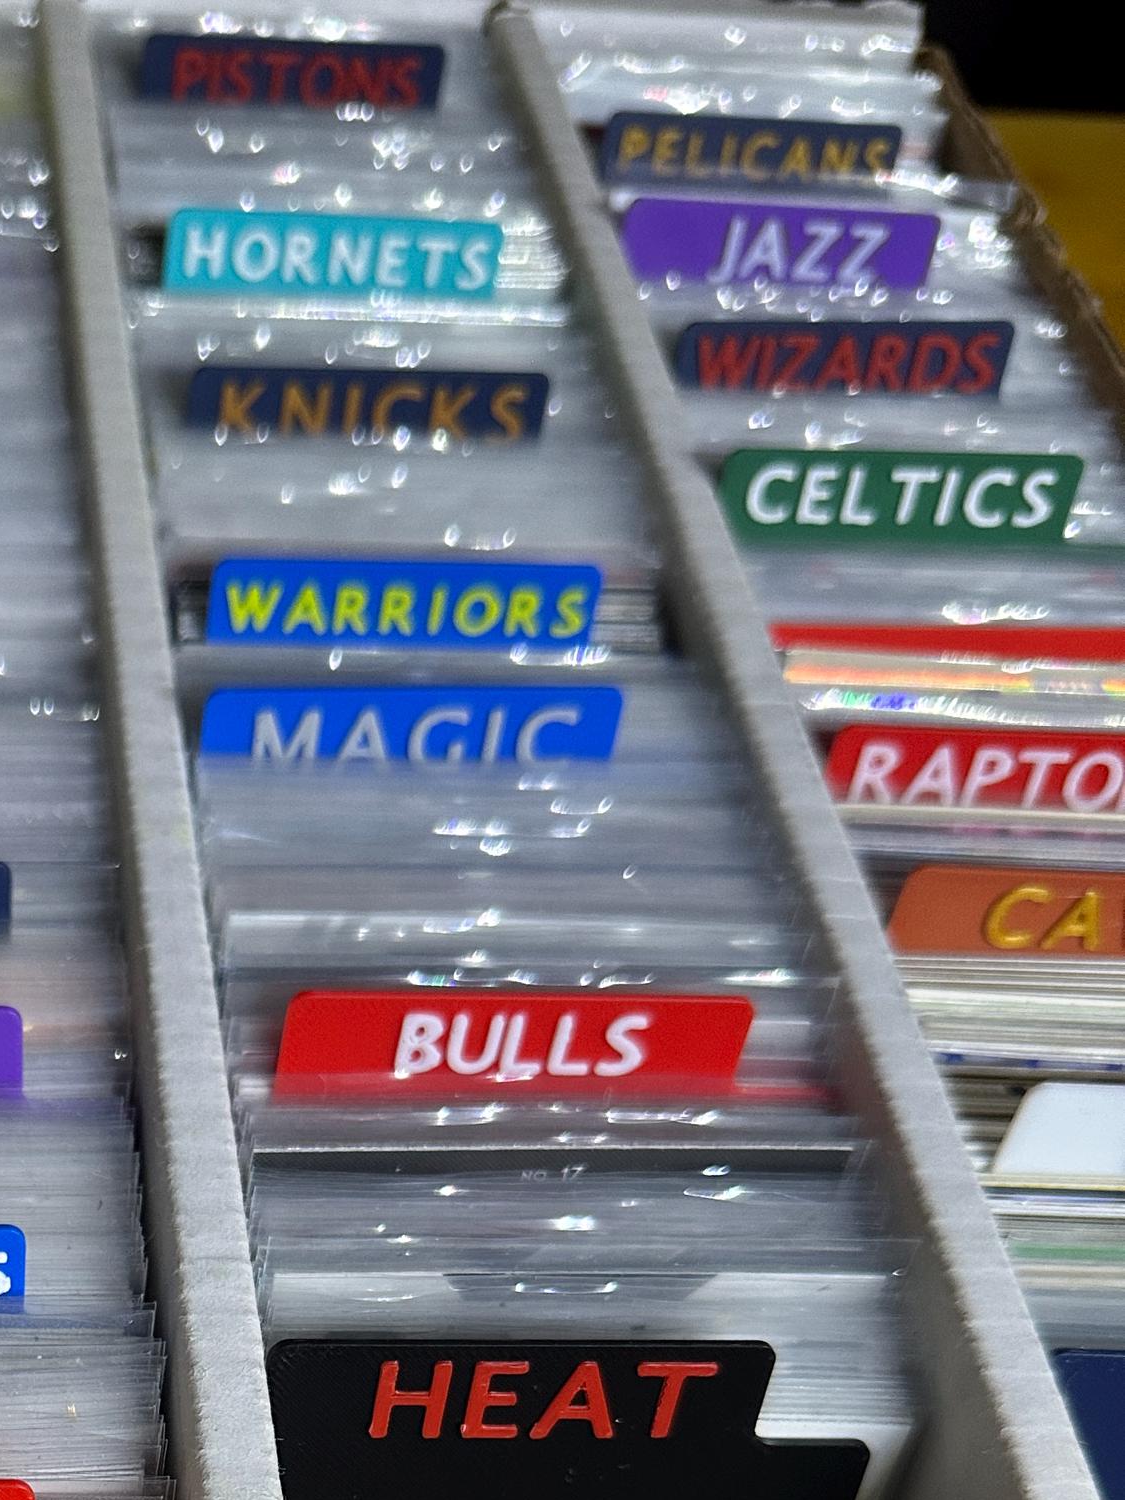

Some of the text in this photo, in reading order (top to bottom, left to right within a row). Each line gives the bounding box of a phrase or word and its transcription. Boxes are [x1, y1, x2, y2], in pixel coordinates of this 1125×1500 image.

[172, 48, 423, 106] PISTONS
[615, 122, 893, 184] PELICANS
[183, 223, 492, 291] HORNETS
[707, 214, 891, 286] JAZZ
[695, 331, 1002, 394] WIZARDS
[216, 380, 531, 445] KNICKS
[745, 462, 1060, 529] CELTICS
[225, 578, 590, 640] WARRIORS
[251, 705, 581, 770] MAGIC
[846, 741, 1125, 815] RAPTO
[984, 884, 1103, 951] CA
[394, 1012, 656, 1079] BULLS
[368, 1360, 720, 1440] HEAT
